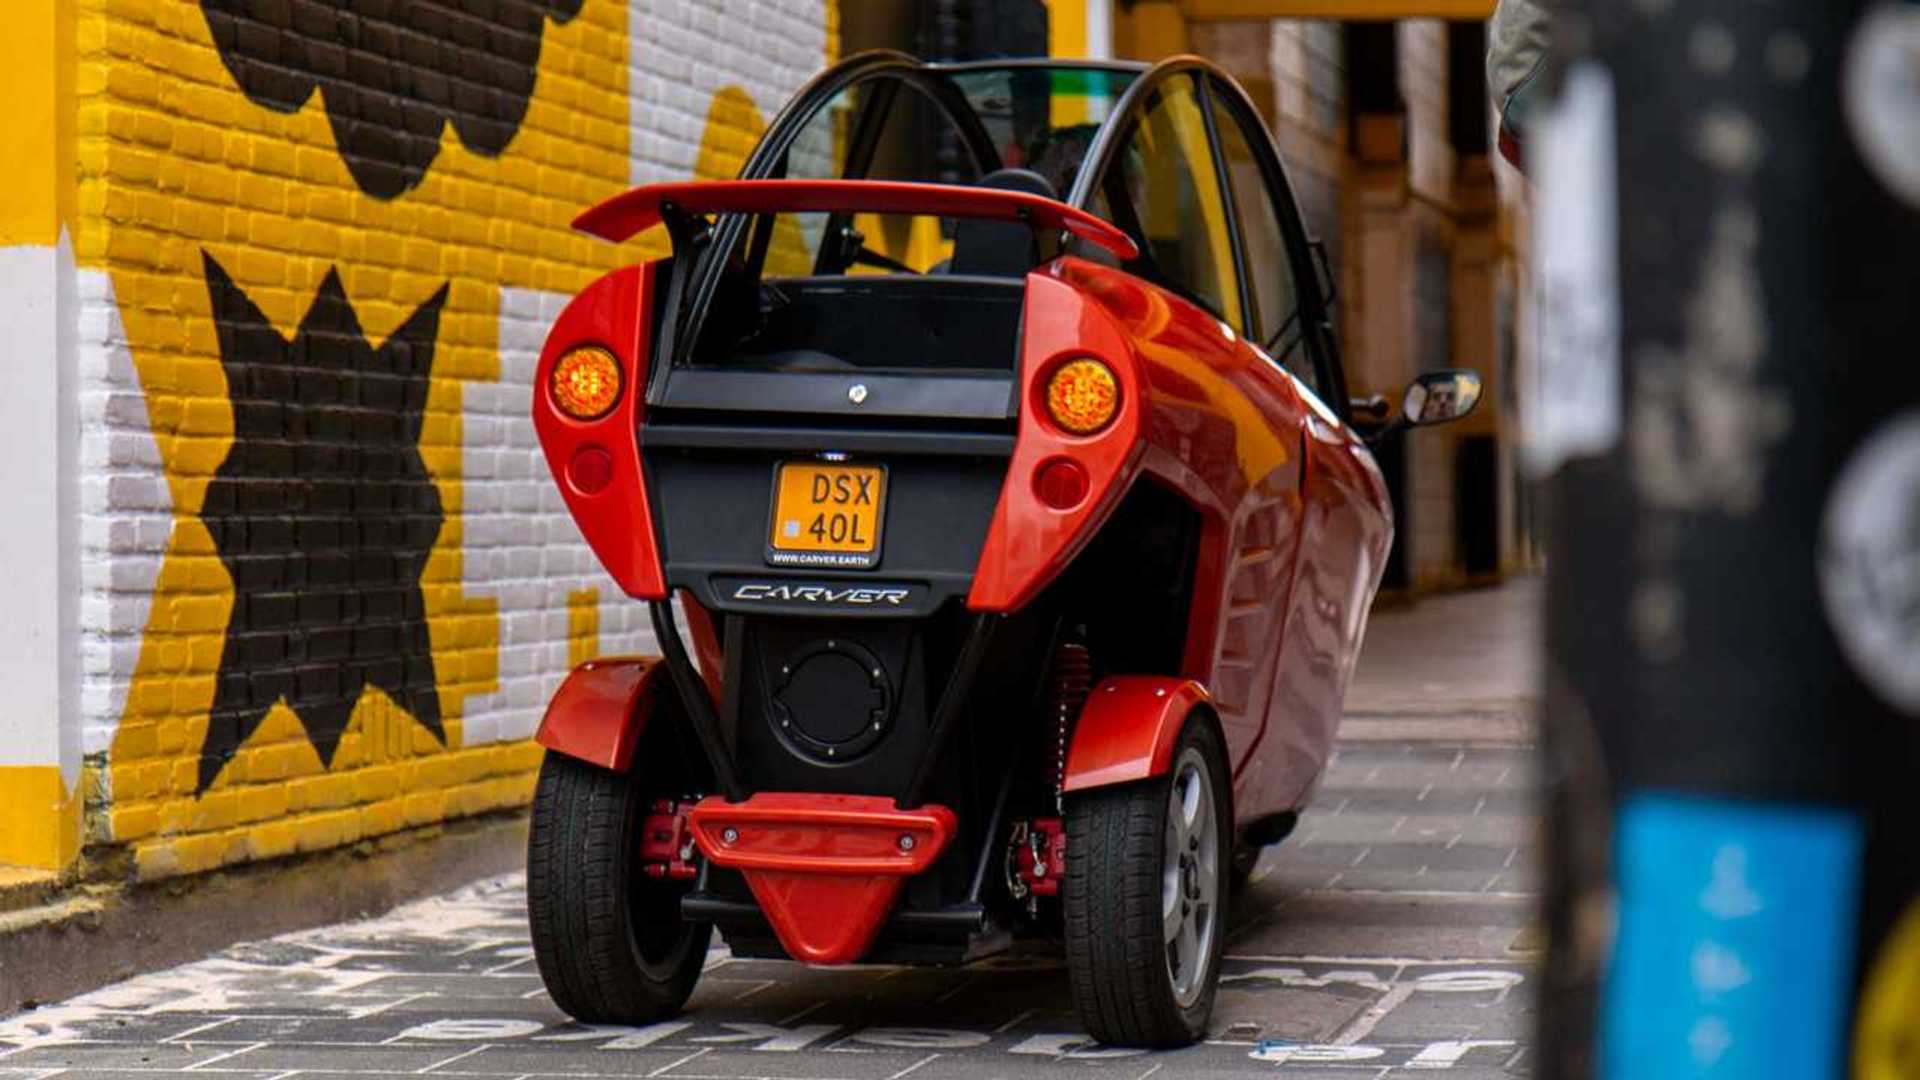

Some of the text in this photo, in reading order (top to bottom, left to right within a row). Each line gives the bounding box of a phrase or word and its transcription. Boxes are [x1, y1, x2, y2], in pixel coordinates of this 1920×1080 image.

[812, 474, 874, 504] DSX
[809, 513, 865, 544] 40L
[773, 553, 870, 565] WWW.CARVER.EARTH
[733, 584, 909, 604] CARVER
